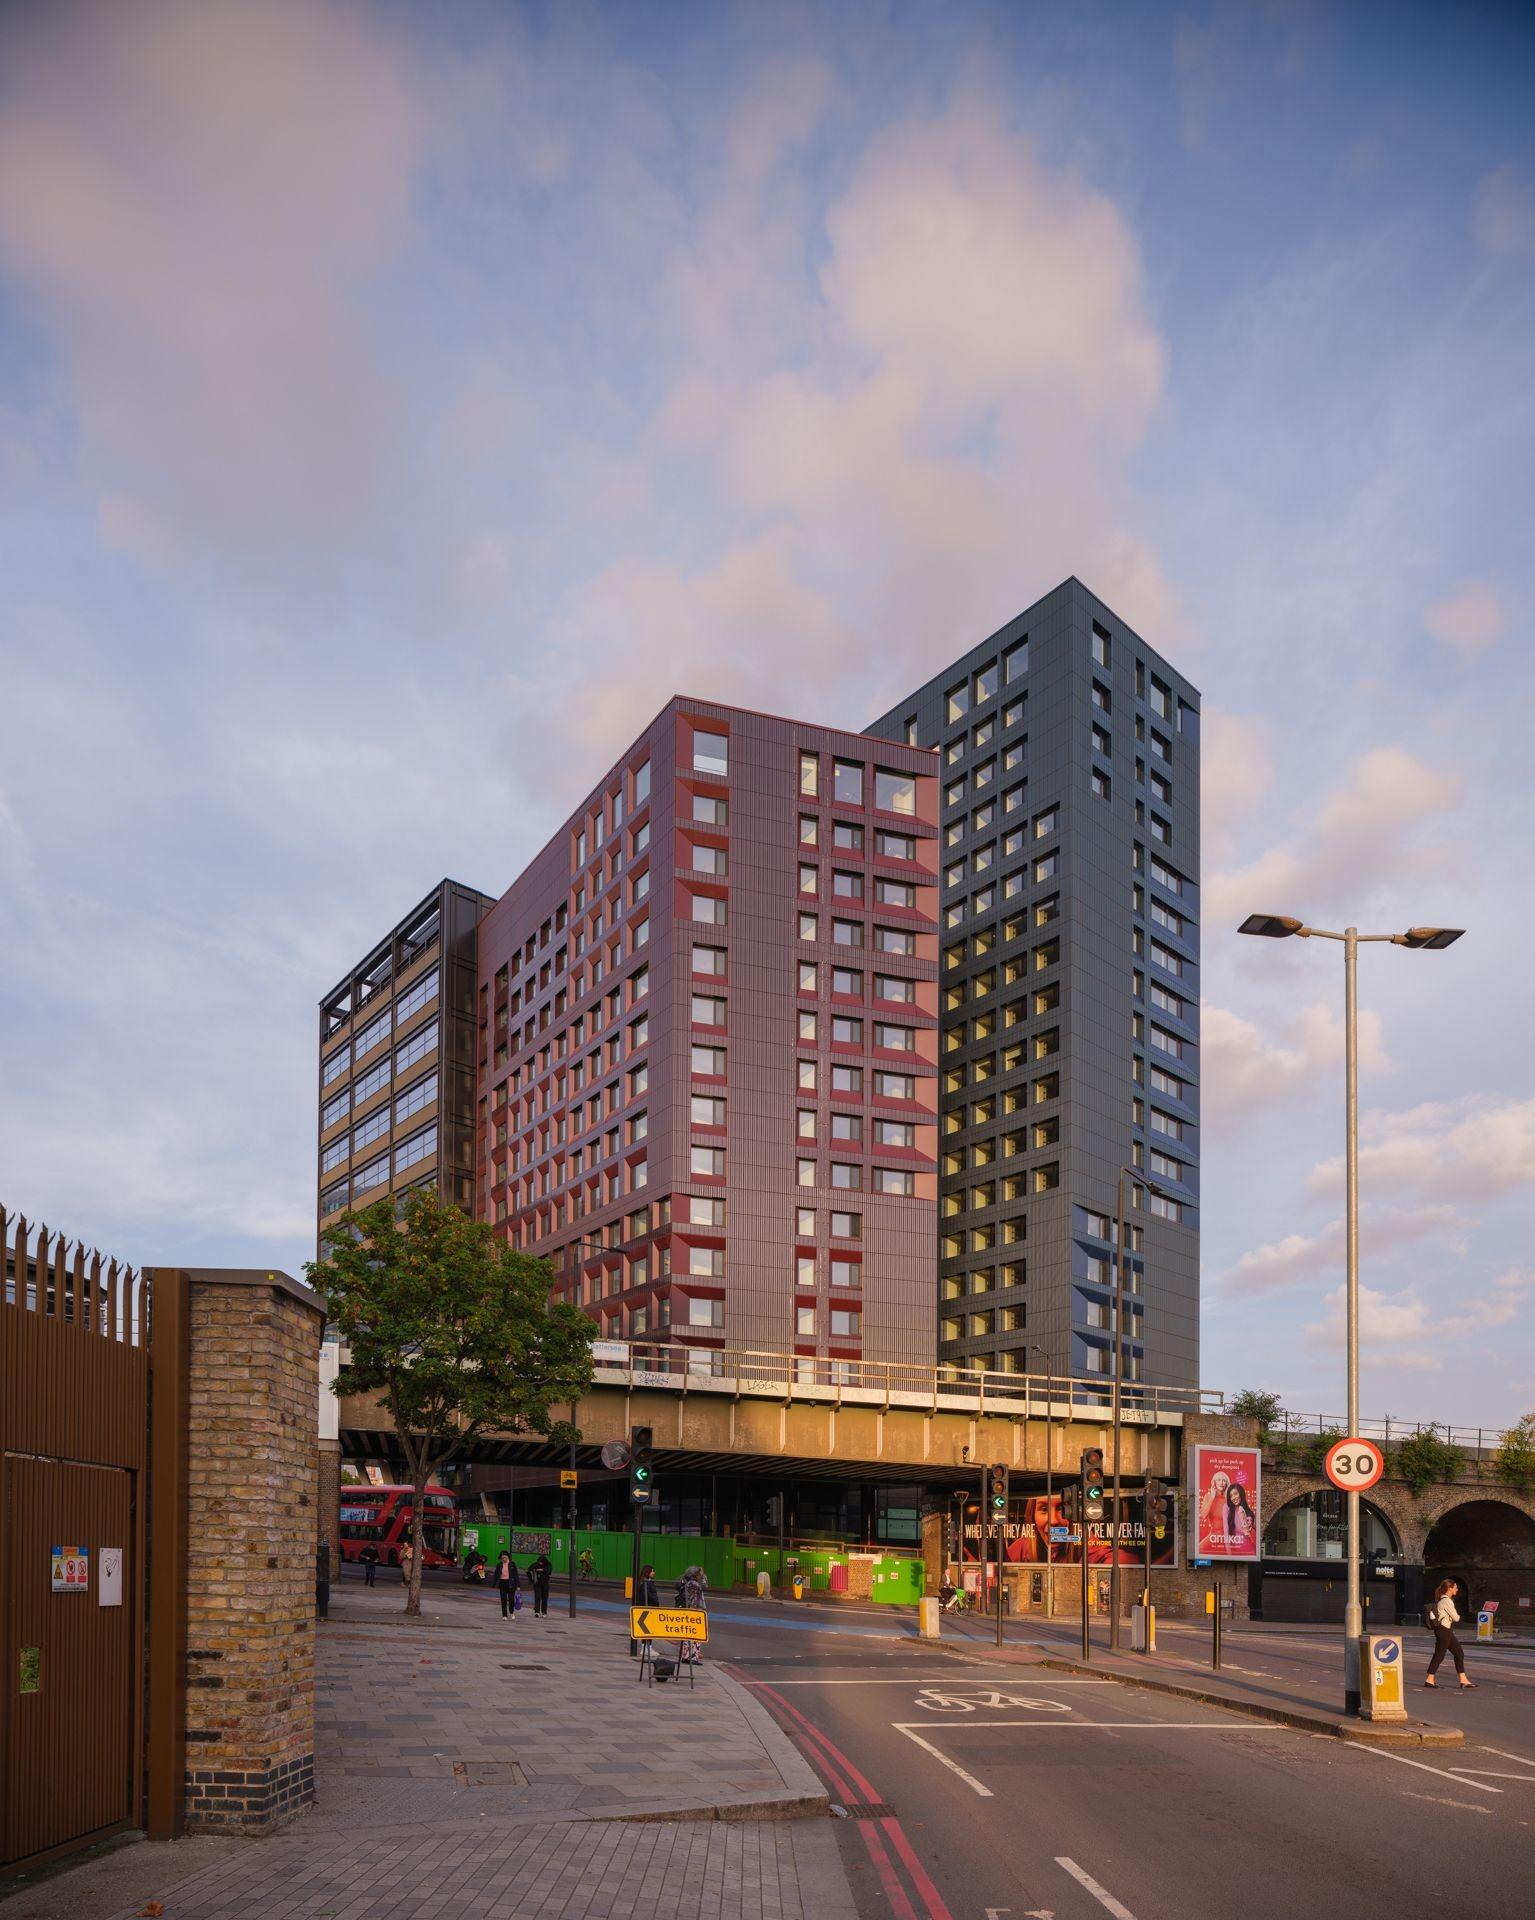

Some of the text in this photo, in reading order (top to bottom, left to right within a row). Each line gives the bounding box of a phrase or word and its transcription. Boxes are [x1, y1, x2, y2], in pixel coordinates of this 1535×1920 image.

[1335, 1455, 1373, 1474] 30
[1003, 1524, 1020, 1538] THEY
[1021, 1524, 1036, 1538] ARE
[1073, 1523, 1104, 1538] THY'RE
[658, 1613, 702, 1624] Diverted
[665, 1625, 697, 1634] traffic
